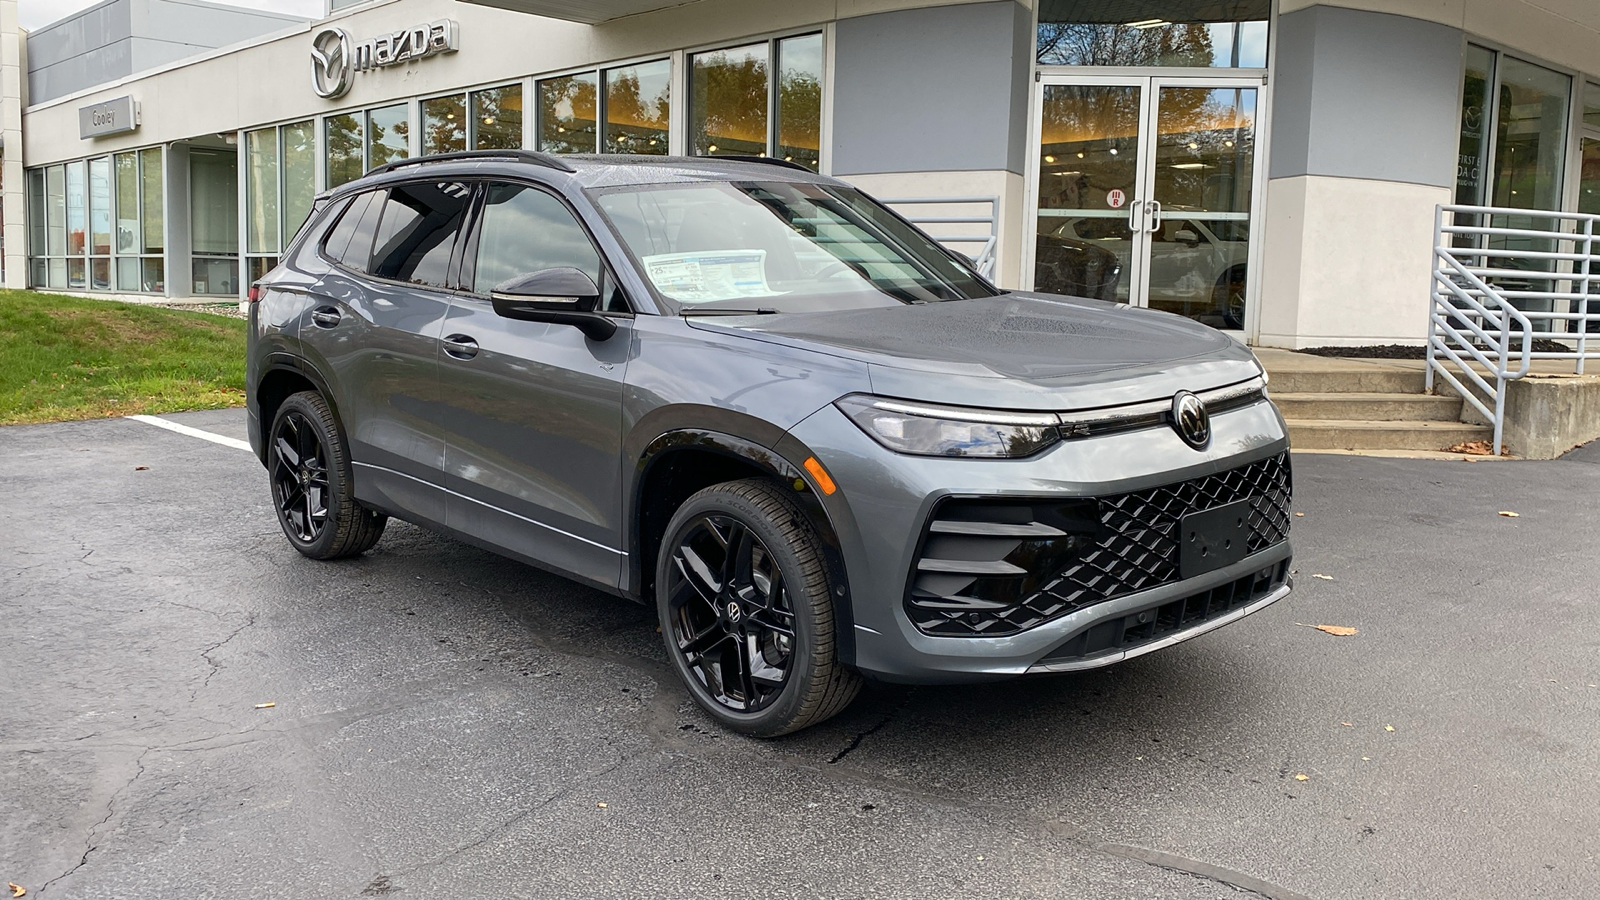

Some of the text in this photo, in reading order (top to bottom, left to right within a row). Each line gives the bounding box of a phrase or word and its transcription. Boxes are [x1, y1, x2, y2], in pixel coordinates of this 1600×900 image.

[353, 18, 459, 72] mazda
[92, 104, 116, 129] Cooley
[726, 499, 775, 538] SCORPION
